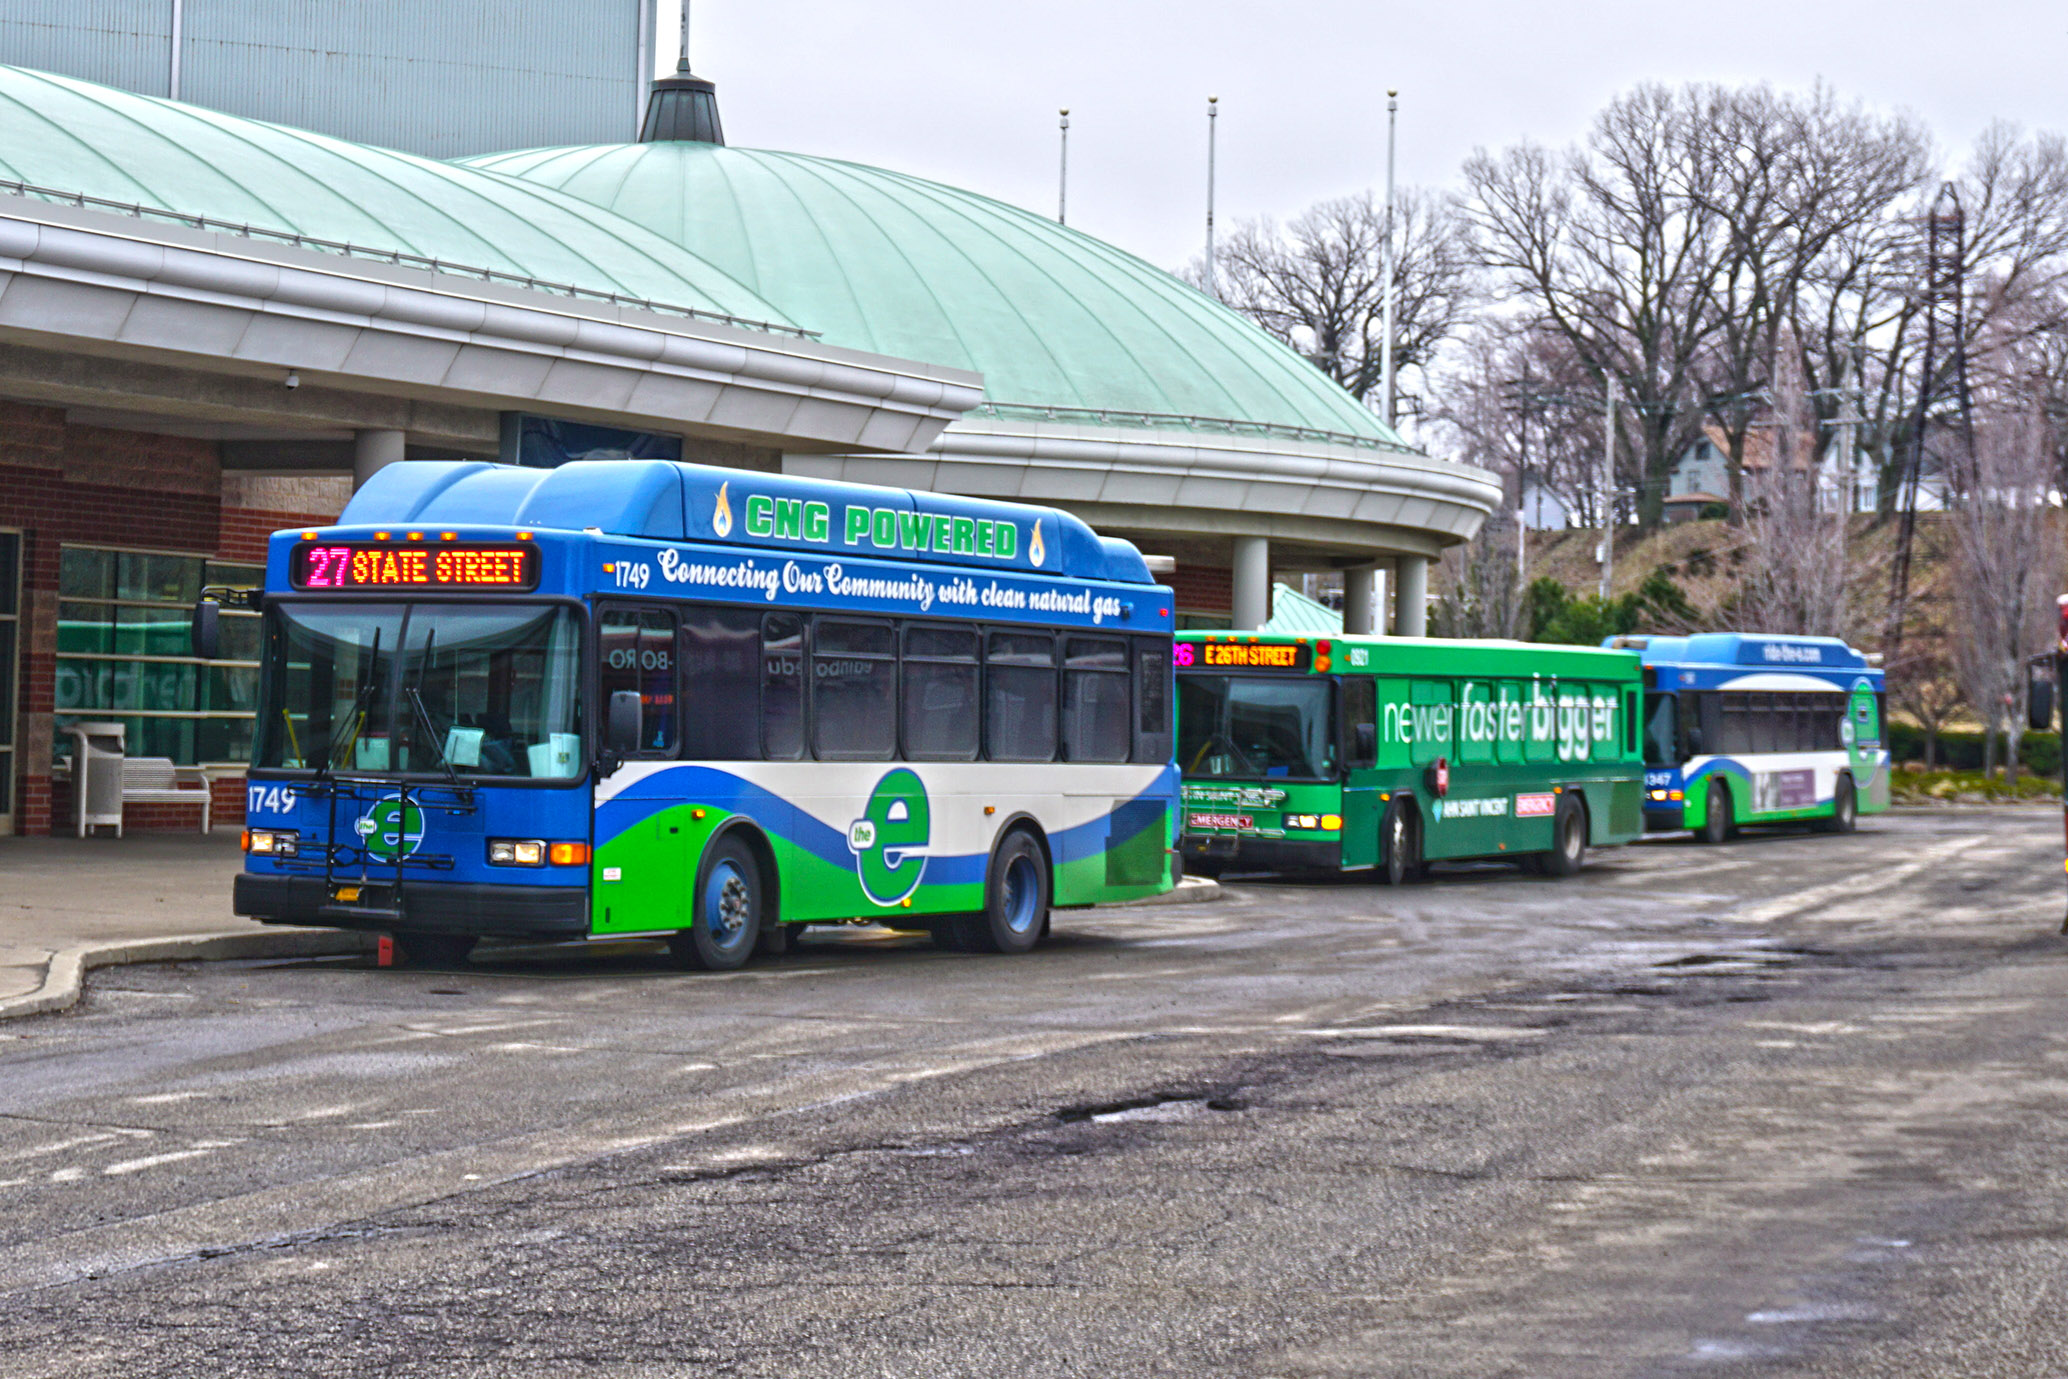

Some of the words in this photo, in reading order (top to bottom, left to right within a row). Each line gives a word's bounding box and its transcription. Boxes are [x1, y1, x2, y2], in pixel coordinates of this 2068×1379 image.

[746, 494, 829, 543] CNG
[844, 504, 1017, 560] POWERED
[307, 547, 351, 587] 27
[352, 551, 429, 584] STATE
[435, 551, 526, 584] STREET
[615, 560, 650, 590] 1749
[657, 548, 780, 601] Connecting
[782, 560, 823, 594] Our
[823, 563, 936, 612] Community
[937, 577, 978, 605] with
[981, 580, 1025, 609] clean
[1028, 589, 1090, 615] natural
[1092, 596, 1121, 625] gas
[1205, 645, 1215, 664] E
[1216, 645, 1248, 665] 26TH
[1248, 646, 1298, 666] STREET
[1384, 702, 1453, 743] newer
[1460, 682, 1528, 742] faster
[1532, 672, 1618, 761] bigger
[250, 786, 296, 814] 1749
[854, 825, 872, 843] the
[857, 767, 930, 907] e
